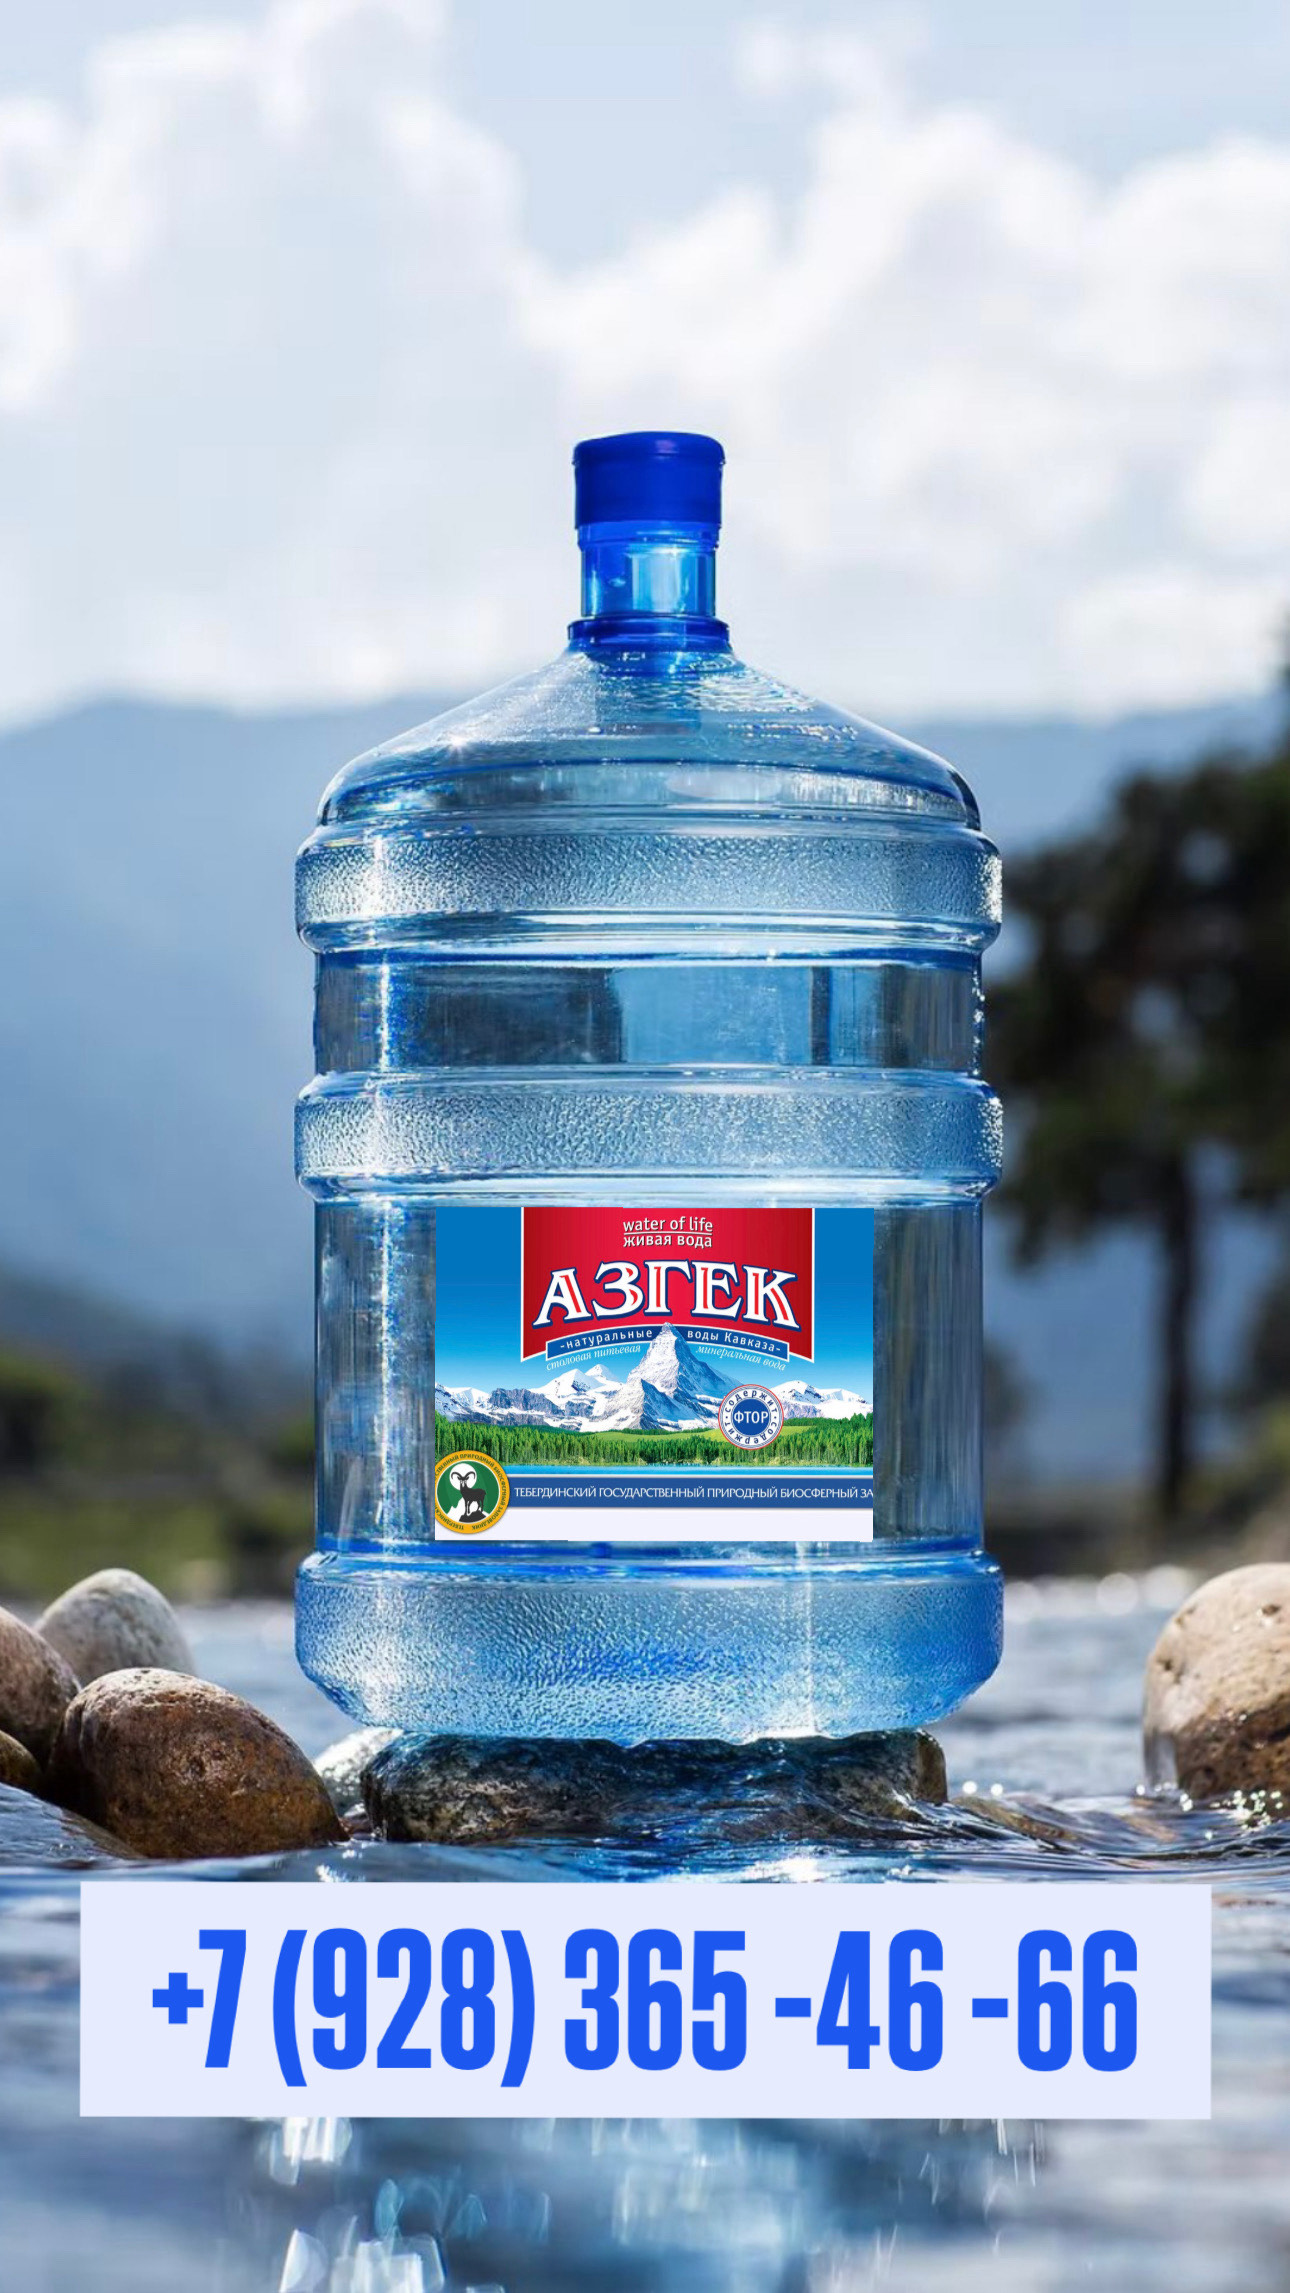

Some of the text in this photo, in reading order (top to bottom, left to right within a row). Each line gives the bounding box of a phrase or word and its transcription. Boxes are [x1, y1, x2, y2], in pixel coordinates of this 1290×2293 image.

[623, 1216, 714, 1233] water of life
[623, 1234, 713, 1249] живая вода
[532, 1259, 801, 1332] АЗГЕК
[687, 1330, 719, 1341] воды
[546, 1345, 787, 1371] столовая питьевая минеральная вода
[725, 1390, 778, 1413] содержит
[733, 1410, 769, 1424] ФТОР
[514, 1485, 596, 1499] ТЕБЕРДИНСКИЙ
[599, 1485, 705, 1500] ГОСУДАРСТВЕННЫЙ
[707, 1486, 778, 1500] ПРИРОДНЫЙ
[780, 1486, 858, 1499] БИОСФЕРНЫЙ
